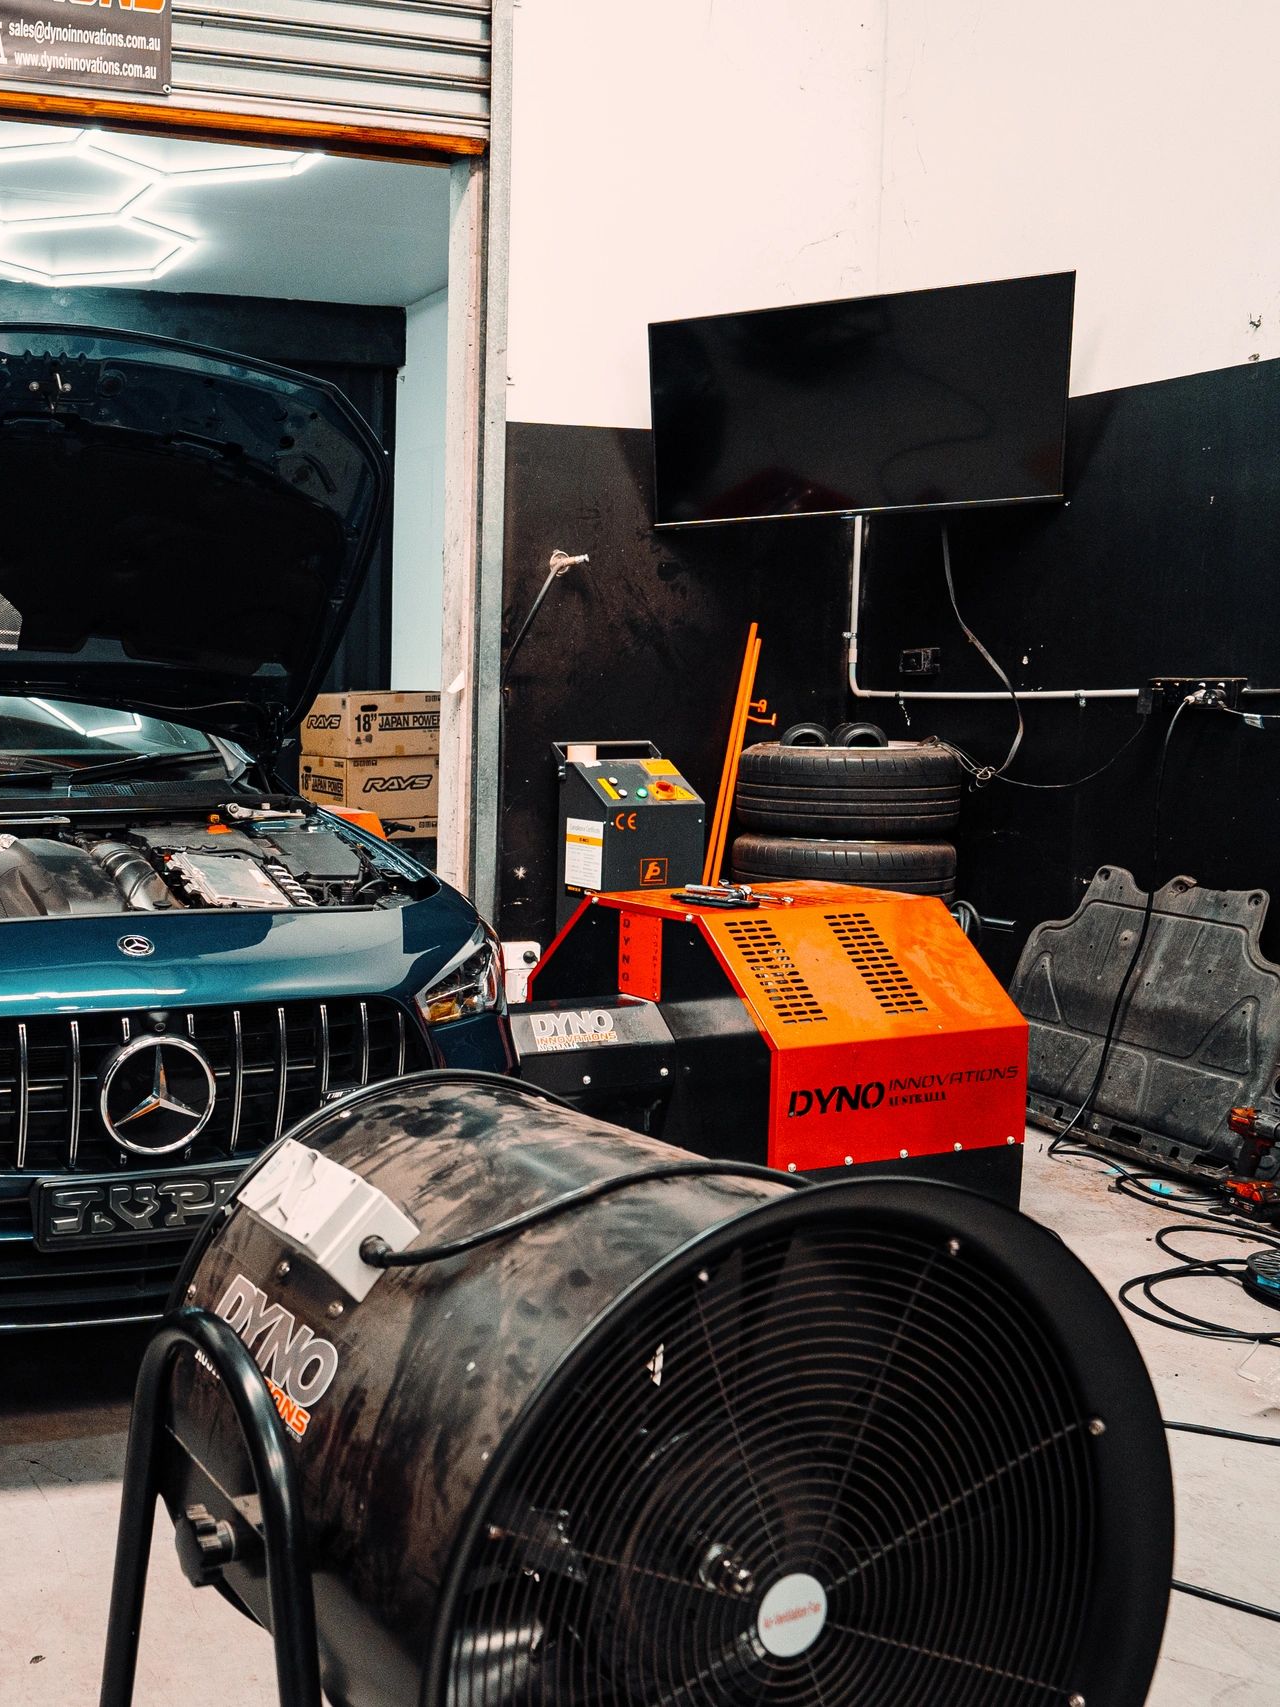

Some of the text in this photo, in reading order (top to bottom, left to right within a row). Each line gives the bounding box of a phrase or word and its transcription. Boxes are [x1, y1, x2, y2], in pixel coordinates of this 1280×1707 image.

[9, 18, 161, 51] sales@dynoinnovations.com.au
[14, 51, 157, 80] www.dynoinnovations.com.au
[307, 715, 341, 729] RAYS
[379, 715, 409, 728] JAPAN
[363, 774, 433, 793] RAYS
[622, 918, 631, 982] DYNO
[530, 1009, 614, 1037] DYNO
[535, 1031, 617, 1046] INNOVATIONS
[538, 1042, 580, 1052] AUSTRALIA
[787, 1065, 1019, 1118] DYNO INNOVATIONS
[888, 1091, 947, 1107] AUSTRALIA
[214, 1273, 339, 1408] DYNO
